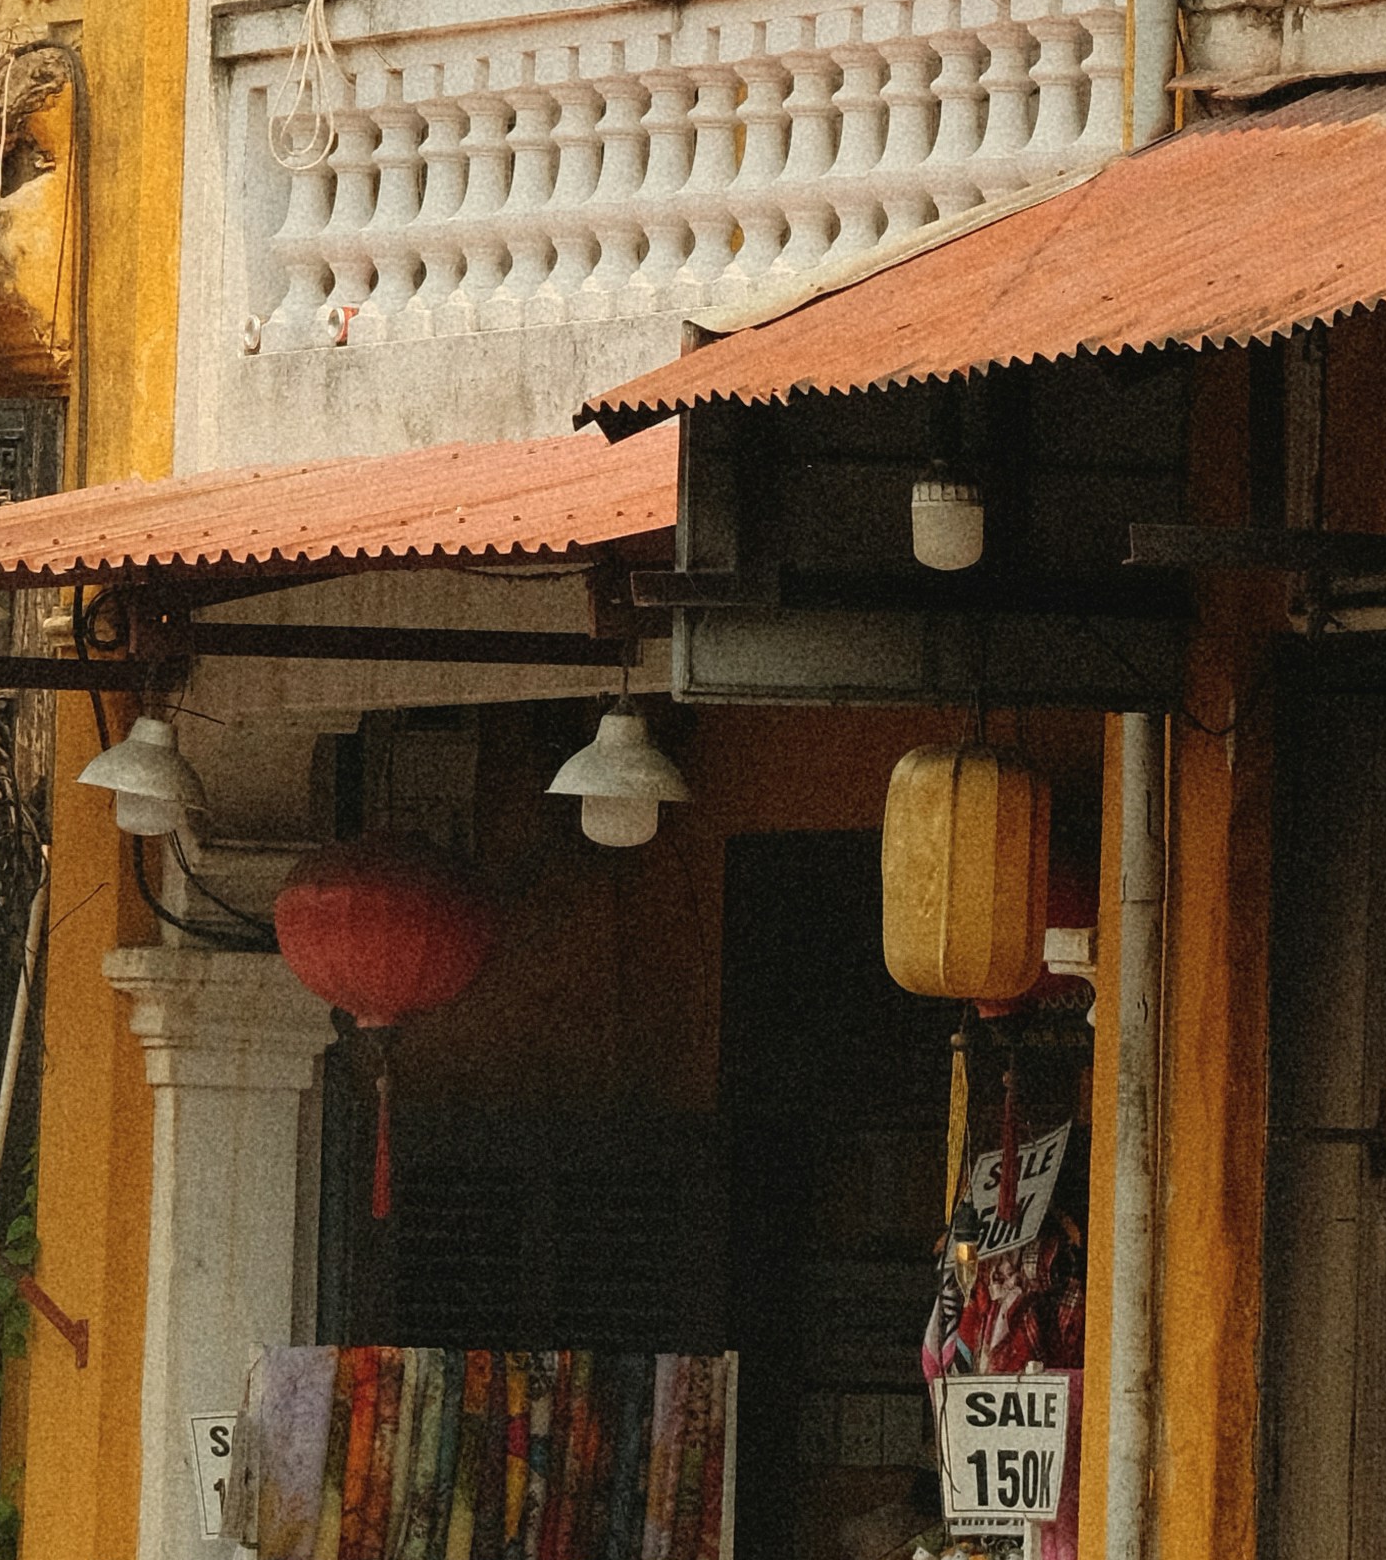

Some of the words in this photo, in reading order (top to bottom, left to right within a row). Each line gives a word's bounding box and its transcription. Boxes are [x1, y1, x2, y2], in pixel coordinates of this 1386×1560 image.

[983, 1141, 1058, 1191] SLE
[965, 1391, 1057, 1429] SALE
[966, 1449, 1055, 1509] 150K
